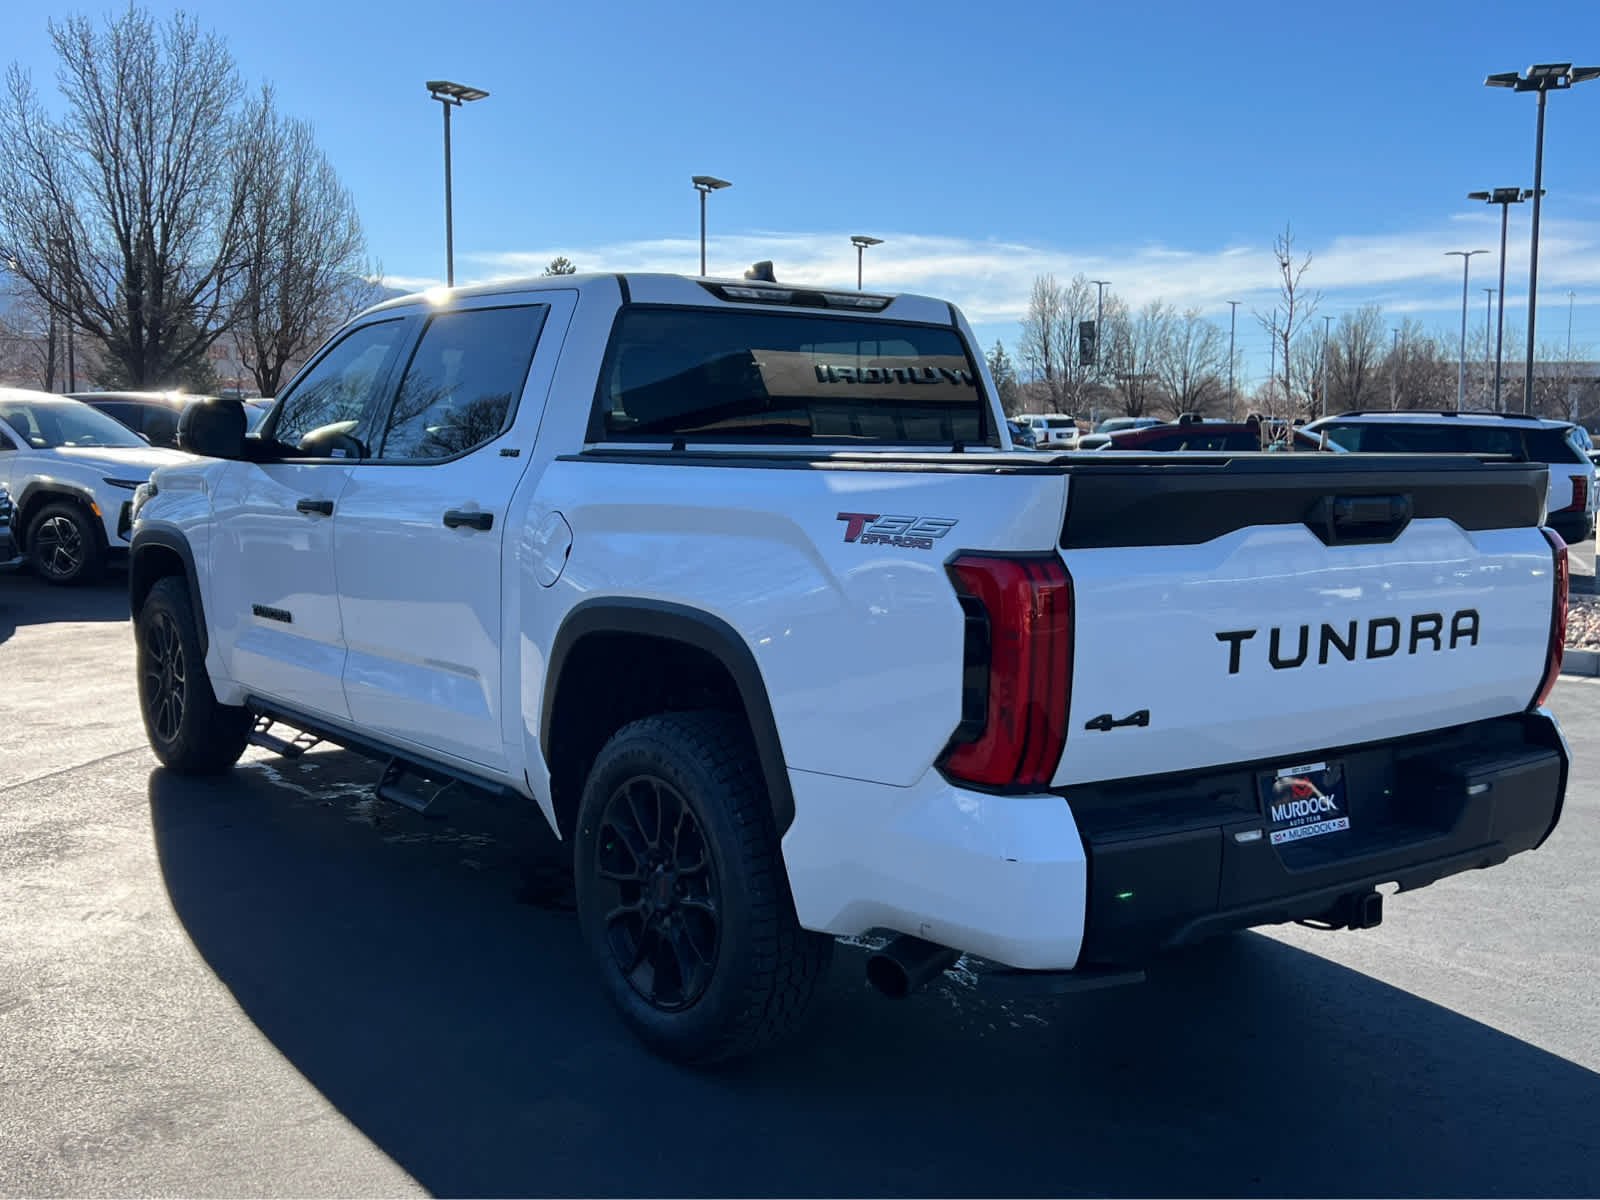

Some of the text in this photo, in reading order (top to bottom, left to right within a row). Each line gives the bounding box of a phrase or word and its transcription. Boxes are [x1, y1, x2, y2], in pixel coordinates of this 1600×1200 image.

[1215, 608, 1480, 675] TUNDRA
[1271, 794, 1338, 822] MURDOCK
[1287, 822, 1332, 839] MURDOCK
